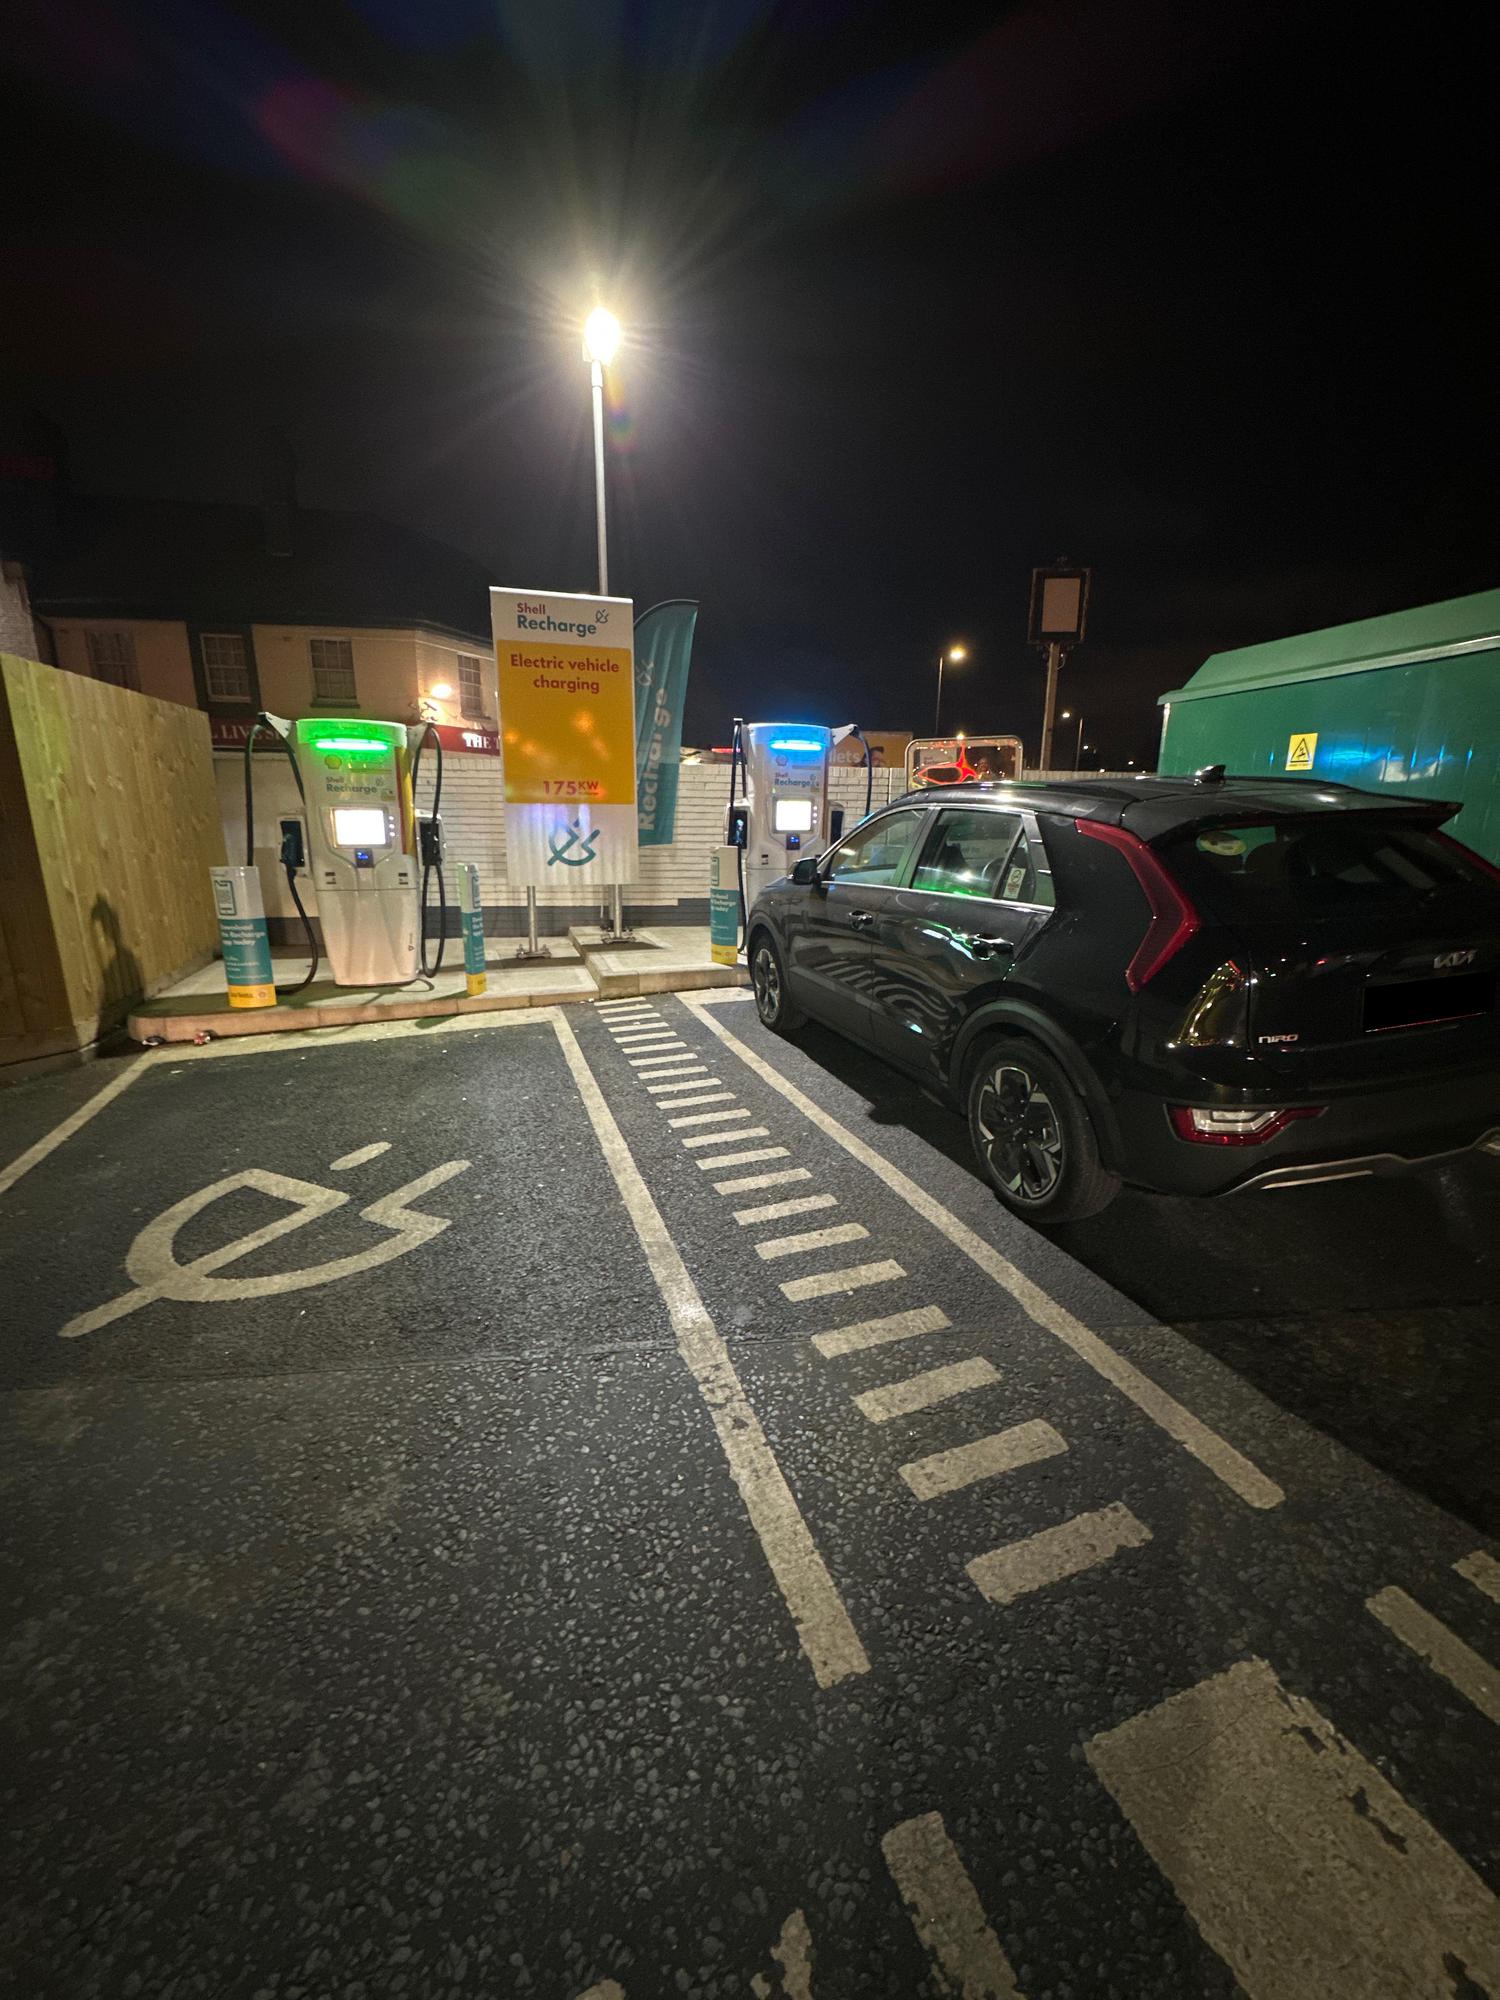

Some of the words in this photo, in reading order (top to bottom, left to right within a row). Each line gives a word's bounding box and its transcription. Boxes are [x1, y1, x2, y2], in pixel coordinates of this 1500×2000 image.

[516, 602, 546, 615] Shell
[516, 614, 598, 638] Recharge
[509, 653, 564, 670] Electric
[568, 656, 620, 673] vehicle
[532, 674, 601, 695] charging
[462, 732, 491, 749] THE
[326, 783, 378, 795] Recharge
[1433, 948, 1479, 969] KIA
[1258, 1033, 1299, 1044] NIRO
